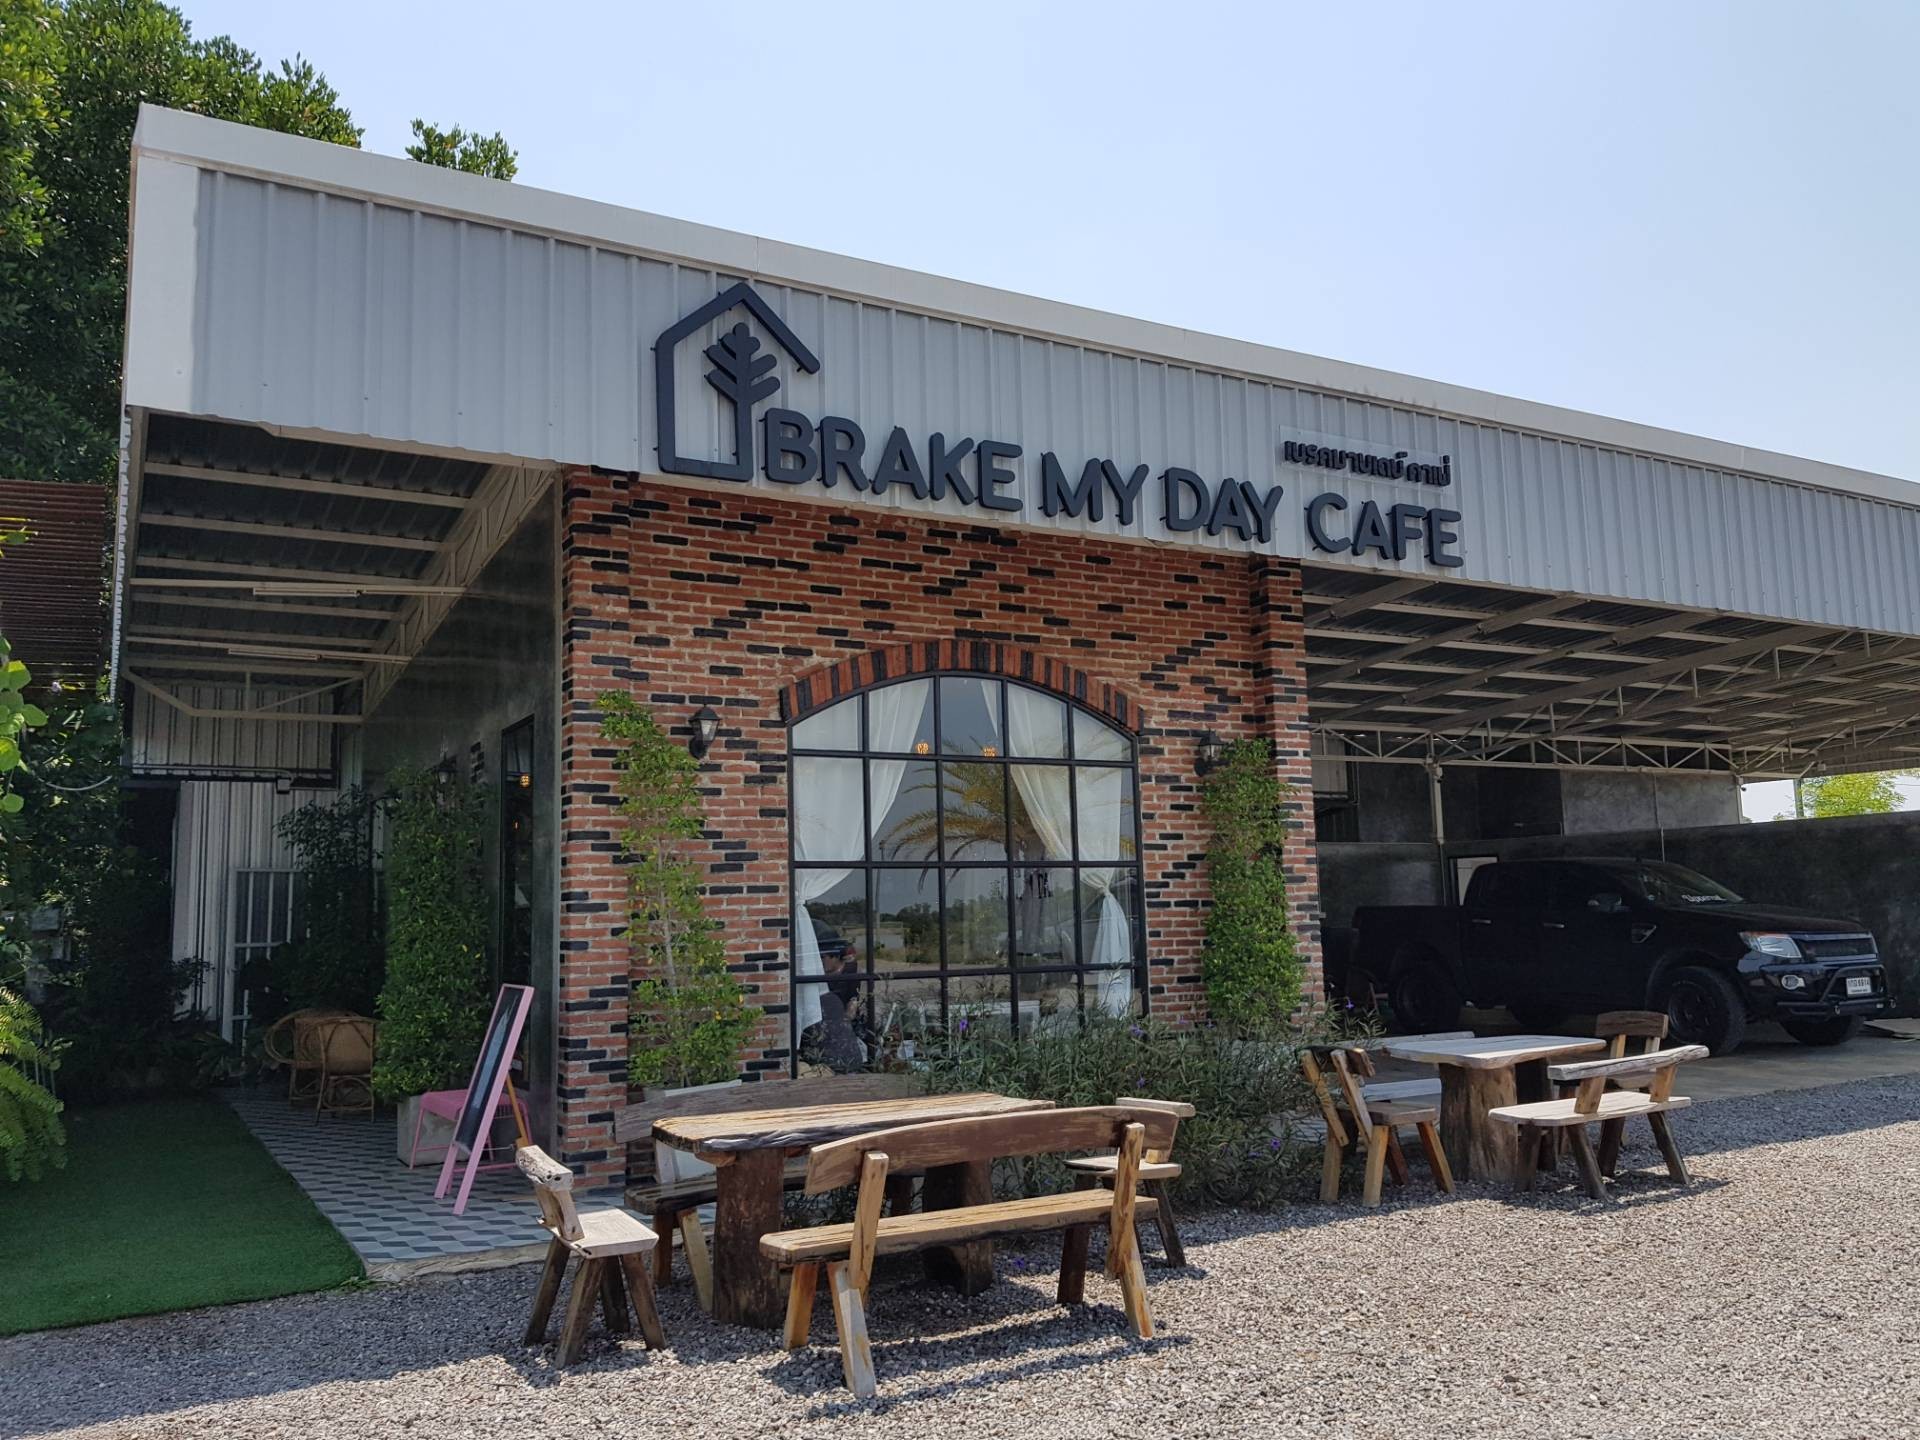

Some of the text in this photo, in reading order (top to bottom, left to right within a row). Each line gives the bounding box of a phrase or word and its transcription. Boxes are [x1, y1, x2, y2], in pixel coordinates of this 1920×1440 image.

[764, 408, 1464, 568] BRAKE MY DAY CAFE
